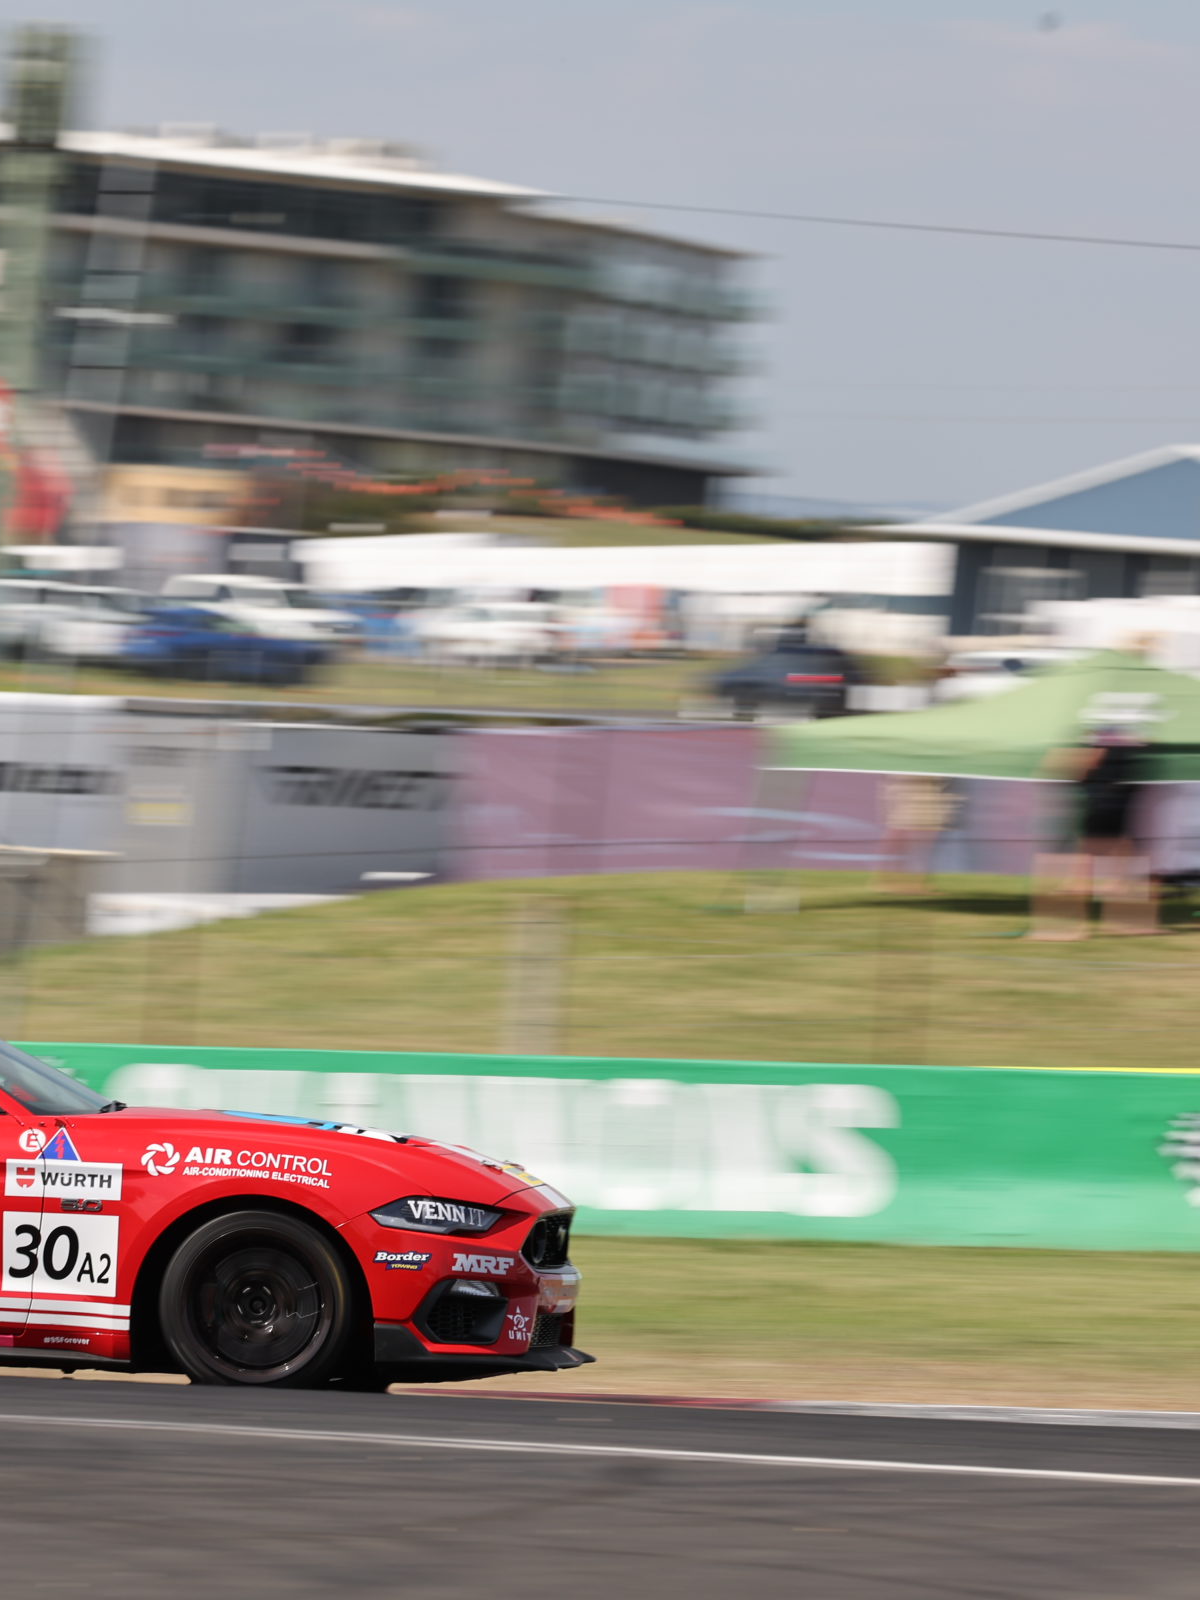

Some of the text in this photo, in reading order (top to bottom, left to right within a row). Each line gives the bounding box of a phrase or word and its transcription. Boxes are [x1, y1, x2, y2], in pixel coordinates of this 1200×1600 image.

[184, 1147, 333, 1176] AIR CONTROL
[182, 1166, 331, 1189] AIR-CONDITIONING ELECTRICAL
[408, 1201, 486, 1227] VENN IT
[9, 1224, 111, 1284] 30 A2
[375, 1252, 430, 1262] Border
[452, 1253, 514, 1276] MRF
